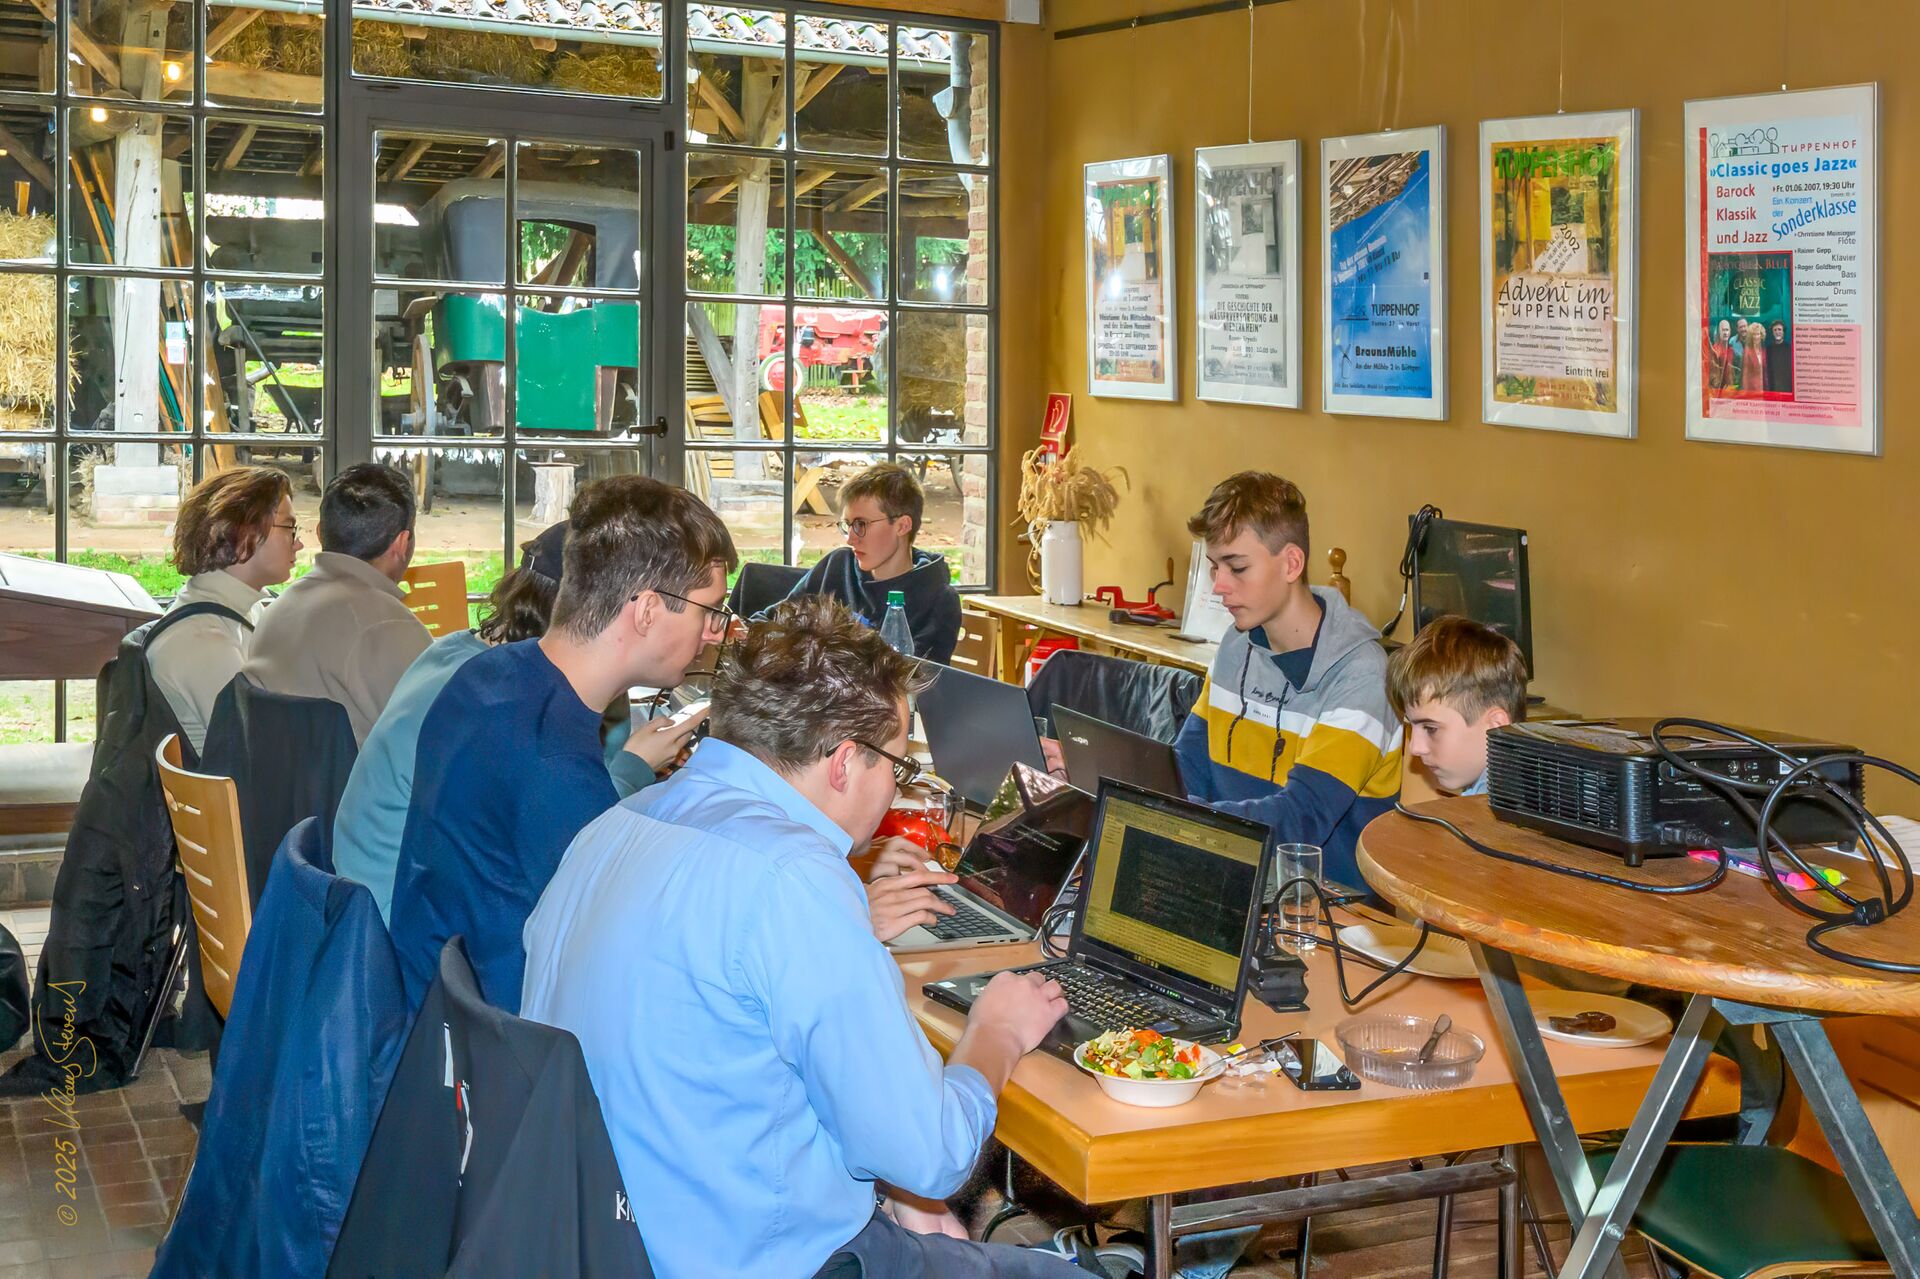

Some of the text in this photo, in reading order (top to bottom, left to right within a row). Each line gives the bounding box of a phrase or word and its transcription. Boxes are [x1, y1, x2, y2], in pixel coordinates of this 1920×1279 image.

[1781, 140, 1857, 154] TUPPENHOF
[1771, 161, 1809, 178] goes
[1716, 184, 1756, 198] Barock
[1841, 181, 1856, 189] Uhr
[1772, 196, 1812, 205] Ein Konzert
[1716, 206, 1757, 221] Klassik
[1772, 198, 1857, 242] Sonderklasse
[1560, 222, 1580, 254] 2002
[1716, 230, 1768, 244] und Jazz
[1831, 254, 1856, 262] Klavier
[1797, 264, 1814, 272] Roger
[1841, 270, 1857, 278] Bass
[1499, 277, 1612, 305] Advent im
[1833, 287, 1857, 295] Drums
[1262, 302, 1273, 312] DER
[1371, 304, 1420, 316] TUPPENHOF
[1498, 302, 1612, 320] TUPPENHOF
[1355, 346, 1417, 358] BraunsMühle
[1565, 365, 1609, 378] Eintritt frei
